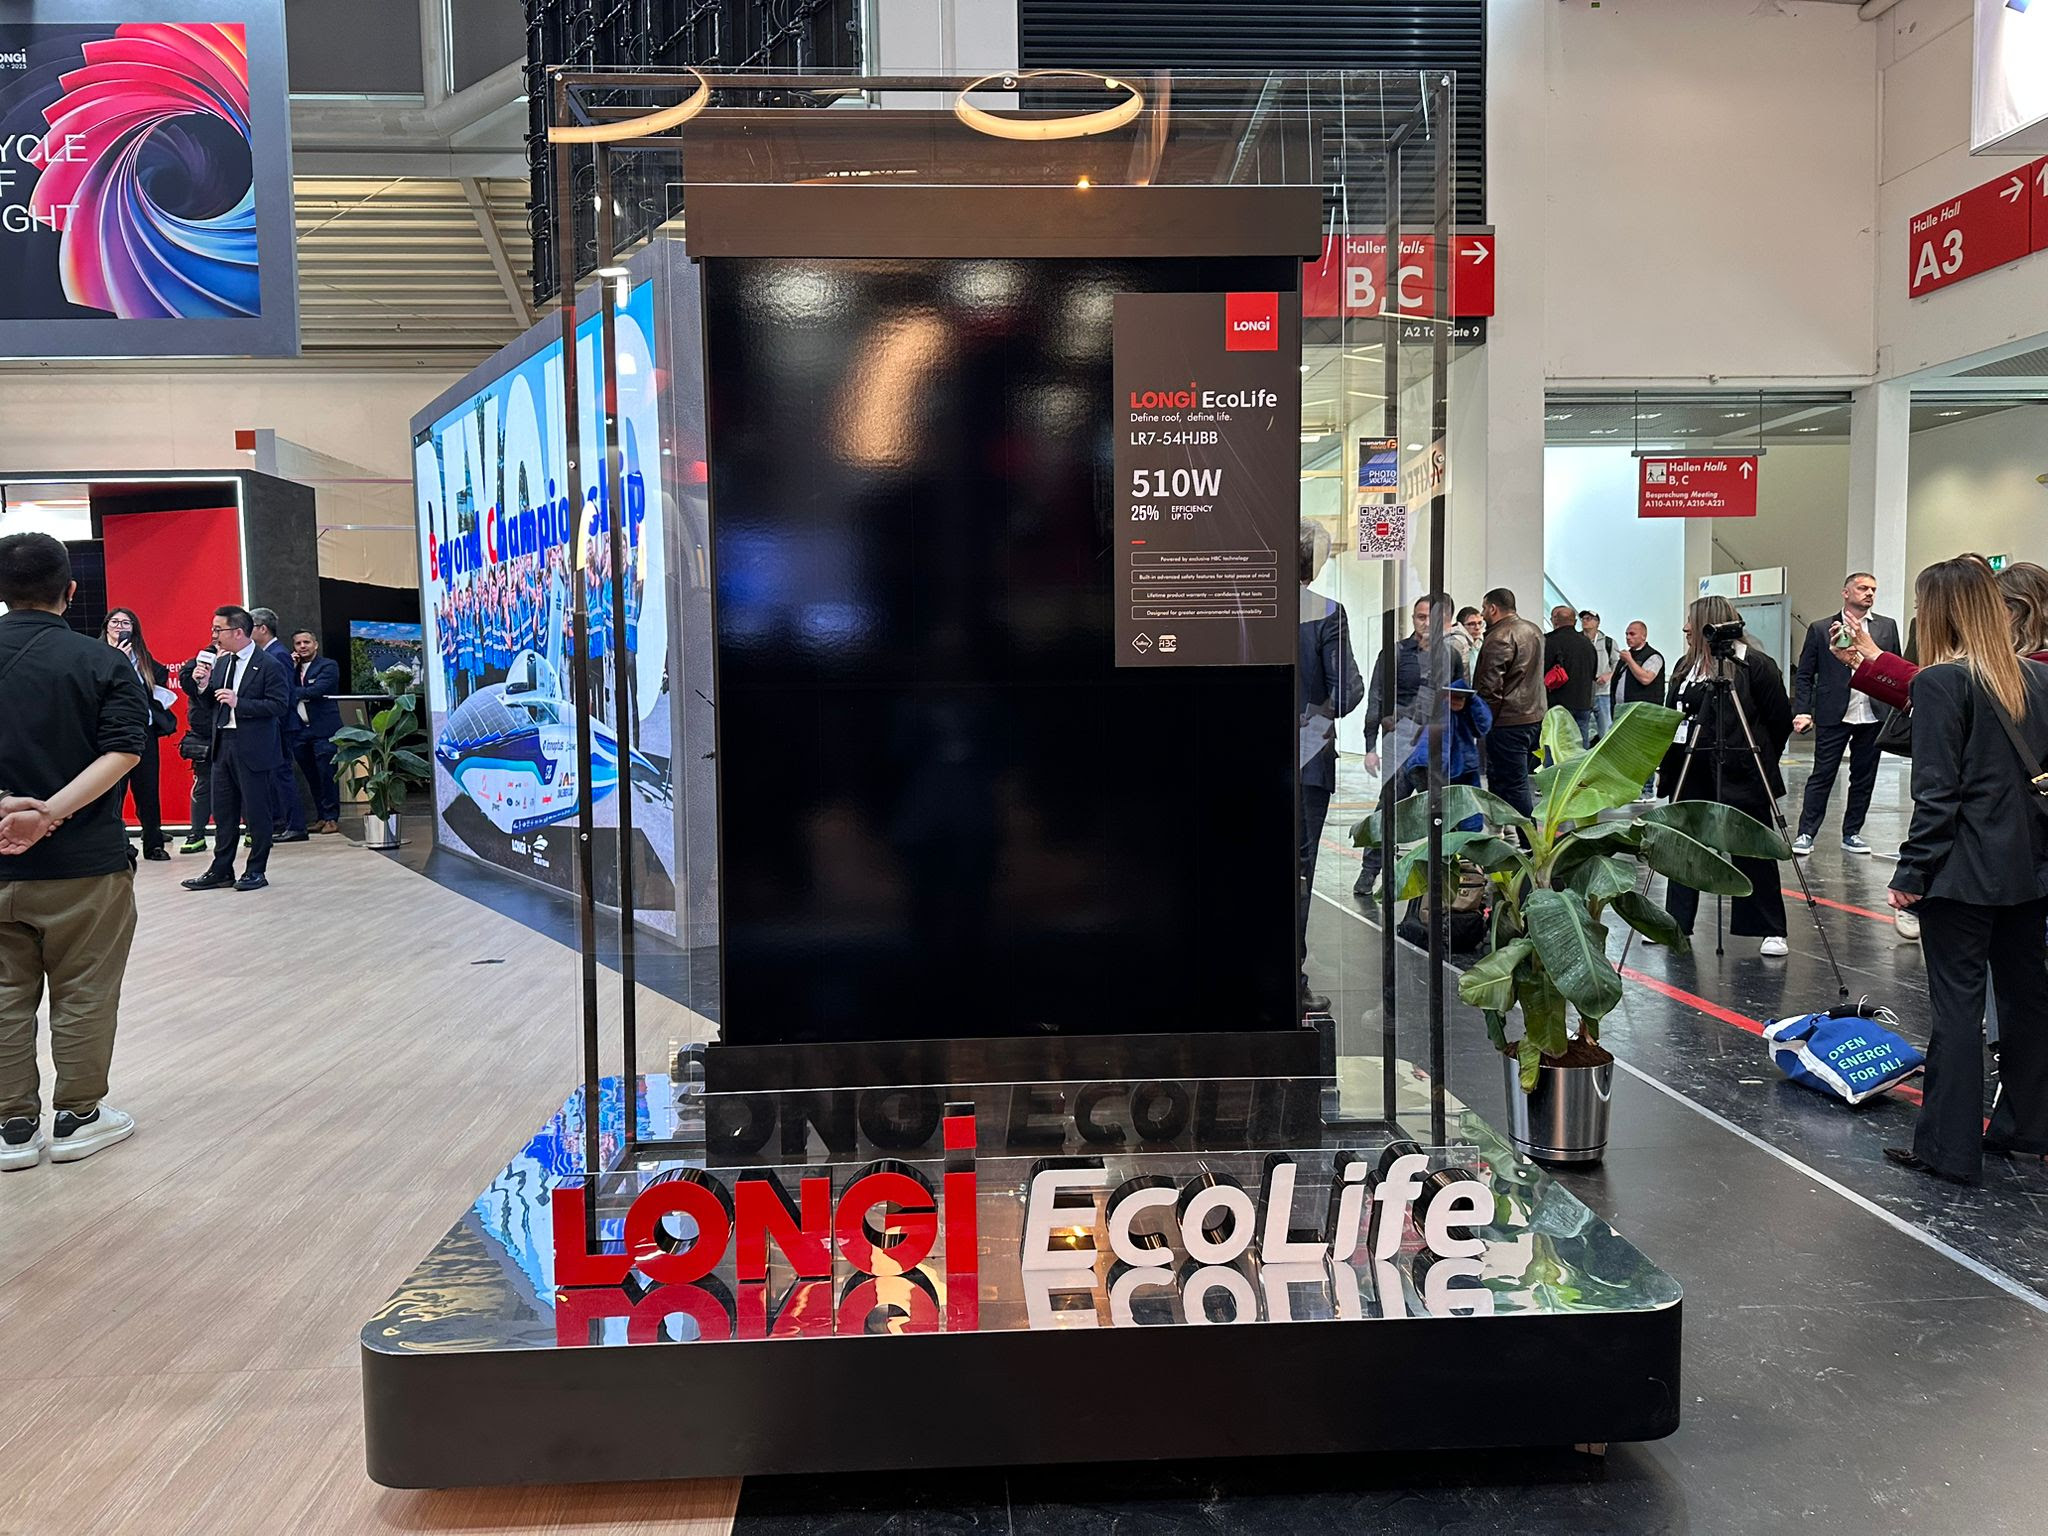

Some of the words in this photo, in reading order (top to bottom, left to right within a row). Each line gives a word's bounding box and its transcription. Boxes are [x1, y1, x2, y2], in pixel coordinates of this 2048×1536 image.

[1913, 210, 1938, 234] Halle
[1940, 201, 1961, 223] Hall
[1913, 229, 1964, 288] A3
[1398, 265, 1423, 308] C
[1233, 316, 1270, 331] LONGi
[1404, 327, 1421, 337] A2
[1472, 326, 1480, 337] 9
[1130, 381, 1196, 409] LONGi
[1202, 389, 1278, 408] EcoLife
[1130, 413, 1159, 422] Define
[1161, 413, 1182, 423] roof,
[1187, 412, 1214, 422] define
[1216, 412, 1233, 422] life.
[1130, 431, 1218, 445] LR7-54HJBB
[1369, 470, 1397, 478] PHOTO
[1669, 462, 1701, 472] Hallen
[1703, 461, 1728, 472] Halls
[1131, 469, 1222, 498] 510W
[1668, 475, 1679, 486] B,
[1681, 475, 1689, 485] C
[1691, 491, 1718, 499] Meeting
[1171, 505, 1213, 513] EFFICIENCY
[1645, 500, 1686, 508] A110-A119,
[1687, 499, 1725, 507] A210-A221
[1131, 505, 1160, 521] 25%
[1828, 1036, 1867, 1061] OPEN
[1837, 1043, 1893, 1070] ENERGY
[1849, 1067, 1879, 1084] FOR
[1881, 1057, 1905, 1074] ALL
[552, 1112, 978, 1286] LONGi
[1021, 1152, 1496, 1271] EcoLife
